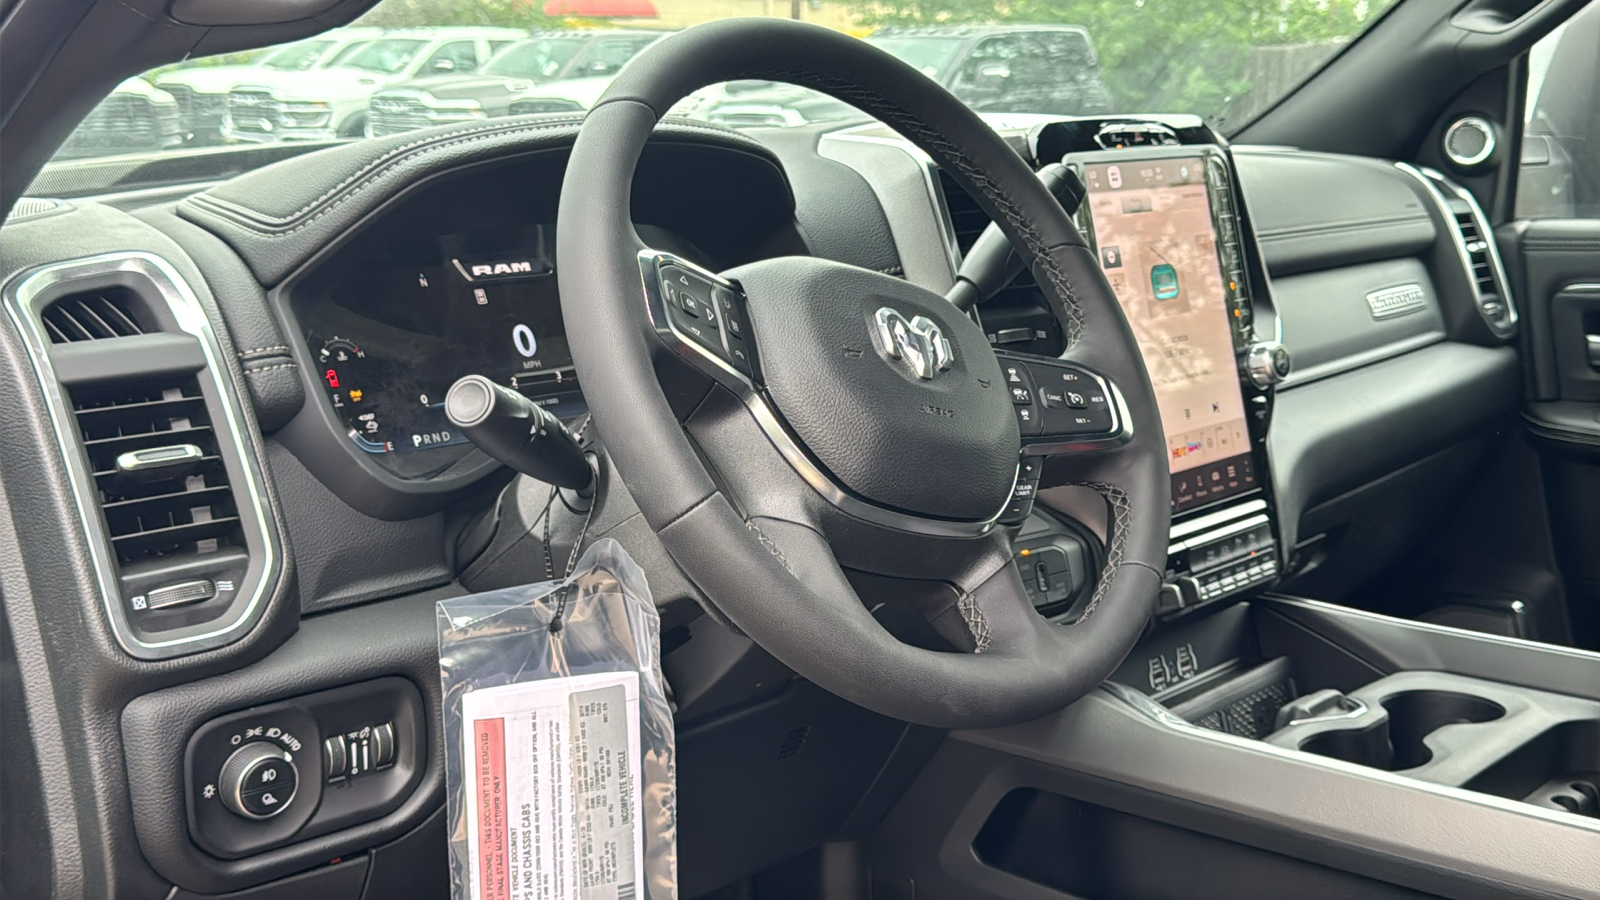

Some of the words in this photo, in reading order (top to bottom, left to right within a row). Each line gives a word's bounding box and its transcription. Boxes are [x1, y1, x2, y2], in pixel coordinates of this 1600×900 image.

[472, 262, 532, 276] RAM
[419, 278, 428, 288] N
[513, 323, 537, 357] 0
[320, 355, 327, 363] C
[357, 350, 365, 358] H
[522, 359, 542, 369] MPH
[333, 394, 340, 403] F
[420, 394, 428, 404] 0
[510, 377, 519, 387] 2
[386, 442, 394, 451] E
[281, 733, 301, 752] AUTO
[481, 733, 489, 764] REMOVED
[483, 766, 489, 775] BE
[618, 750, 626, 779] VEHICLE
[483, 777, 489, 786] TO
[483, 790, 491, 826] DOCUMENT
[620, 781, 629, 825] INCOMPLETE
[521, 803, 530, 828] CABS
[510, 827, 518, 862] DOCUMENT
[522, 830, 532, 868] CHASSIS
[511, 865, 519, 891] VEHICLE
[524, 871, 532, 889] AND
